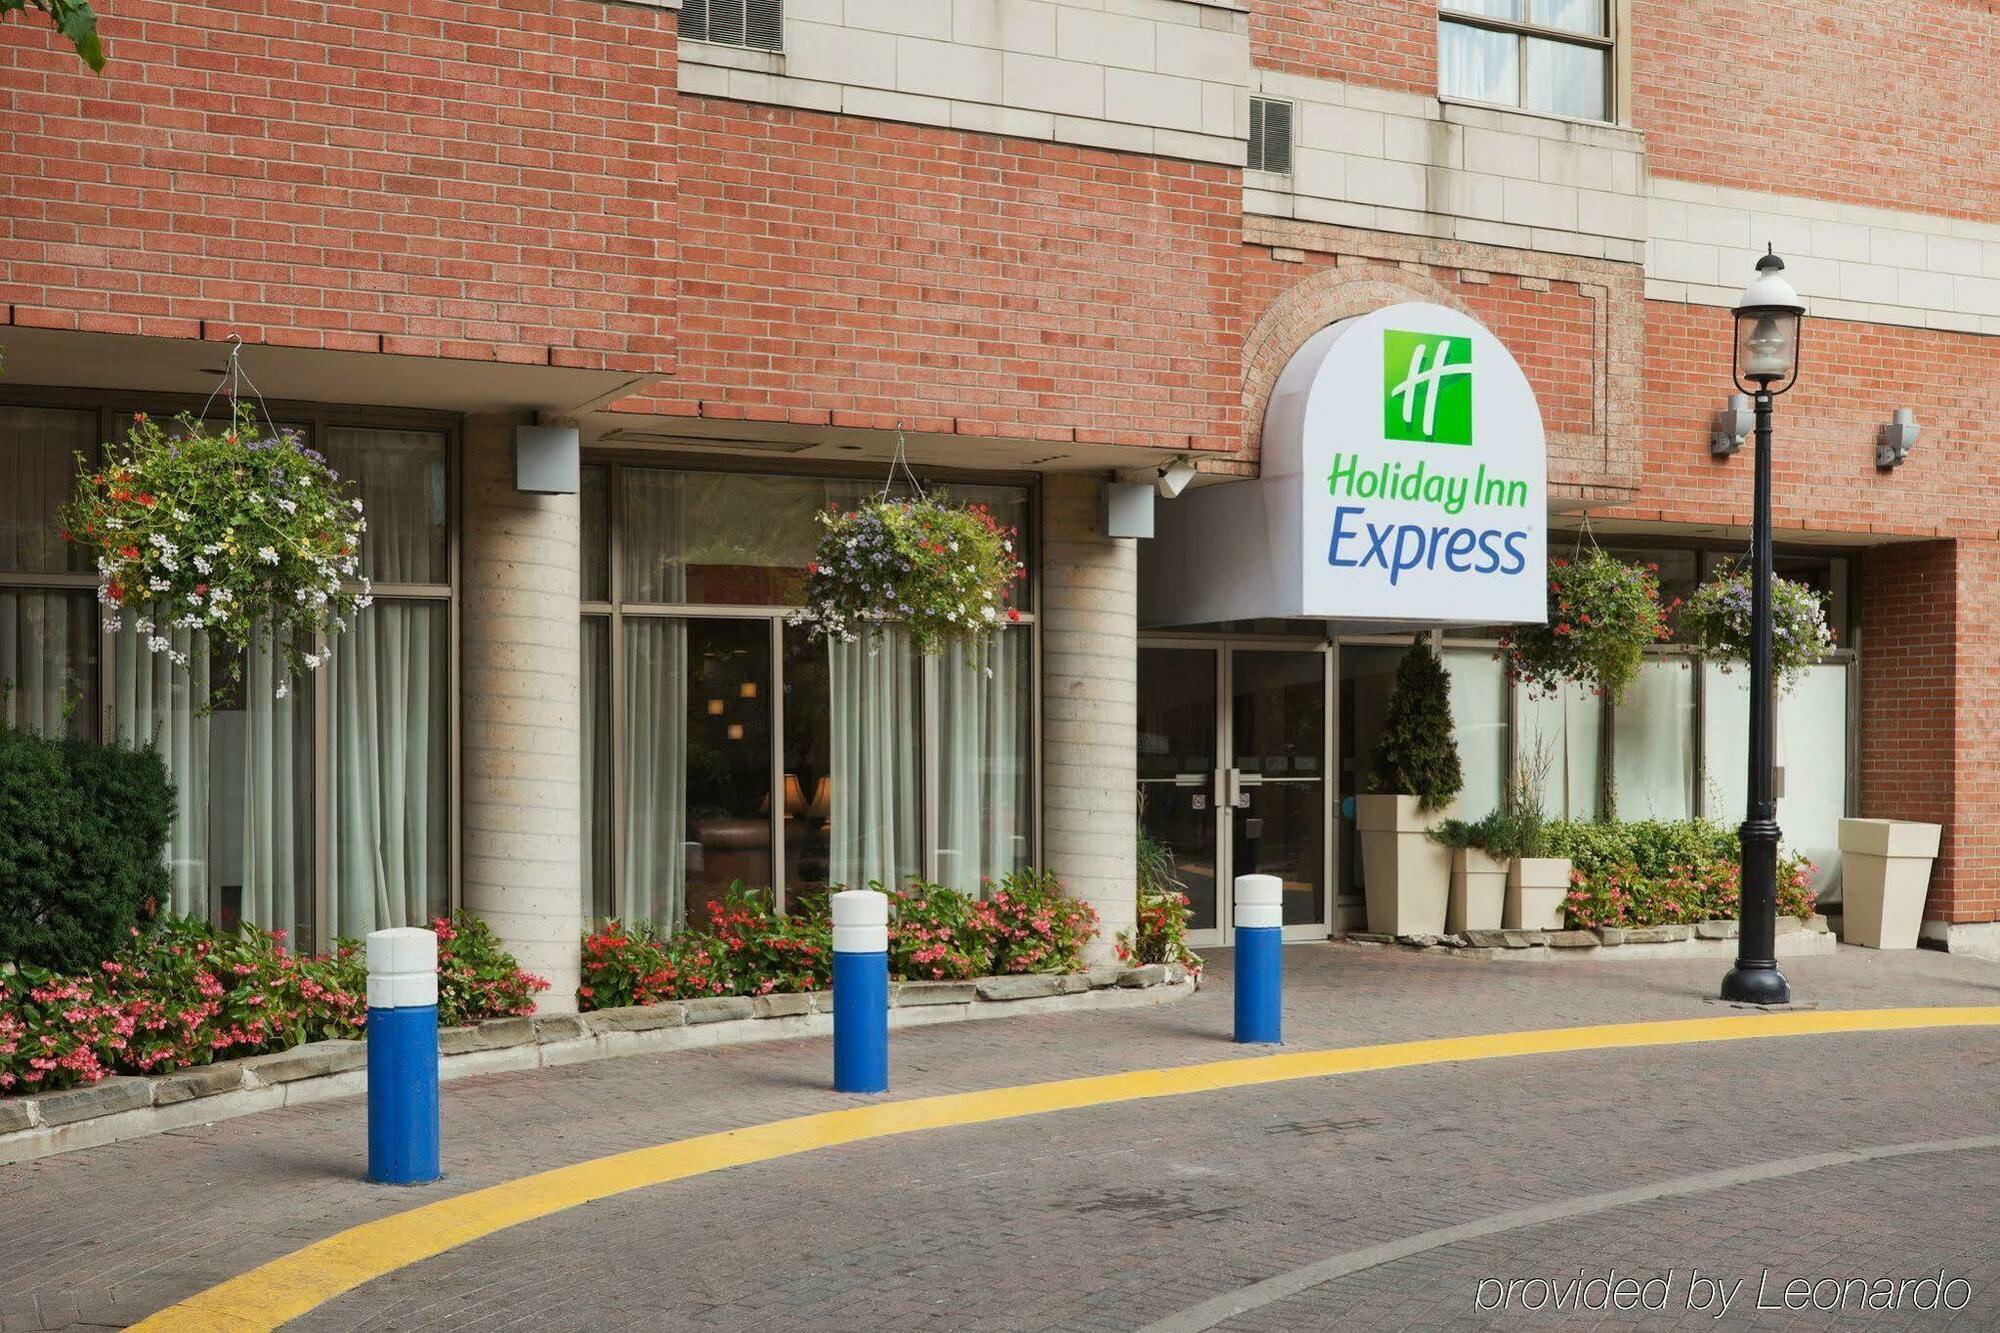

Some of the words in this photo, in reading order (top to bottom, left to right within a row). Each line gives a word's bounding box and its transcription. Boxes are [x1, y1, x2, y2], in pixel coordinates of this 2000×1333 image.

[1327, 452, 1469, 515] Holiday
[1475, 463, 1528, 508] Inn
[1327, 505, 1528, 587] Express
